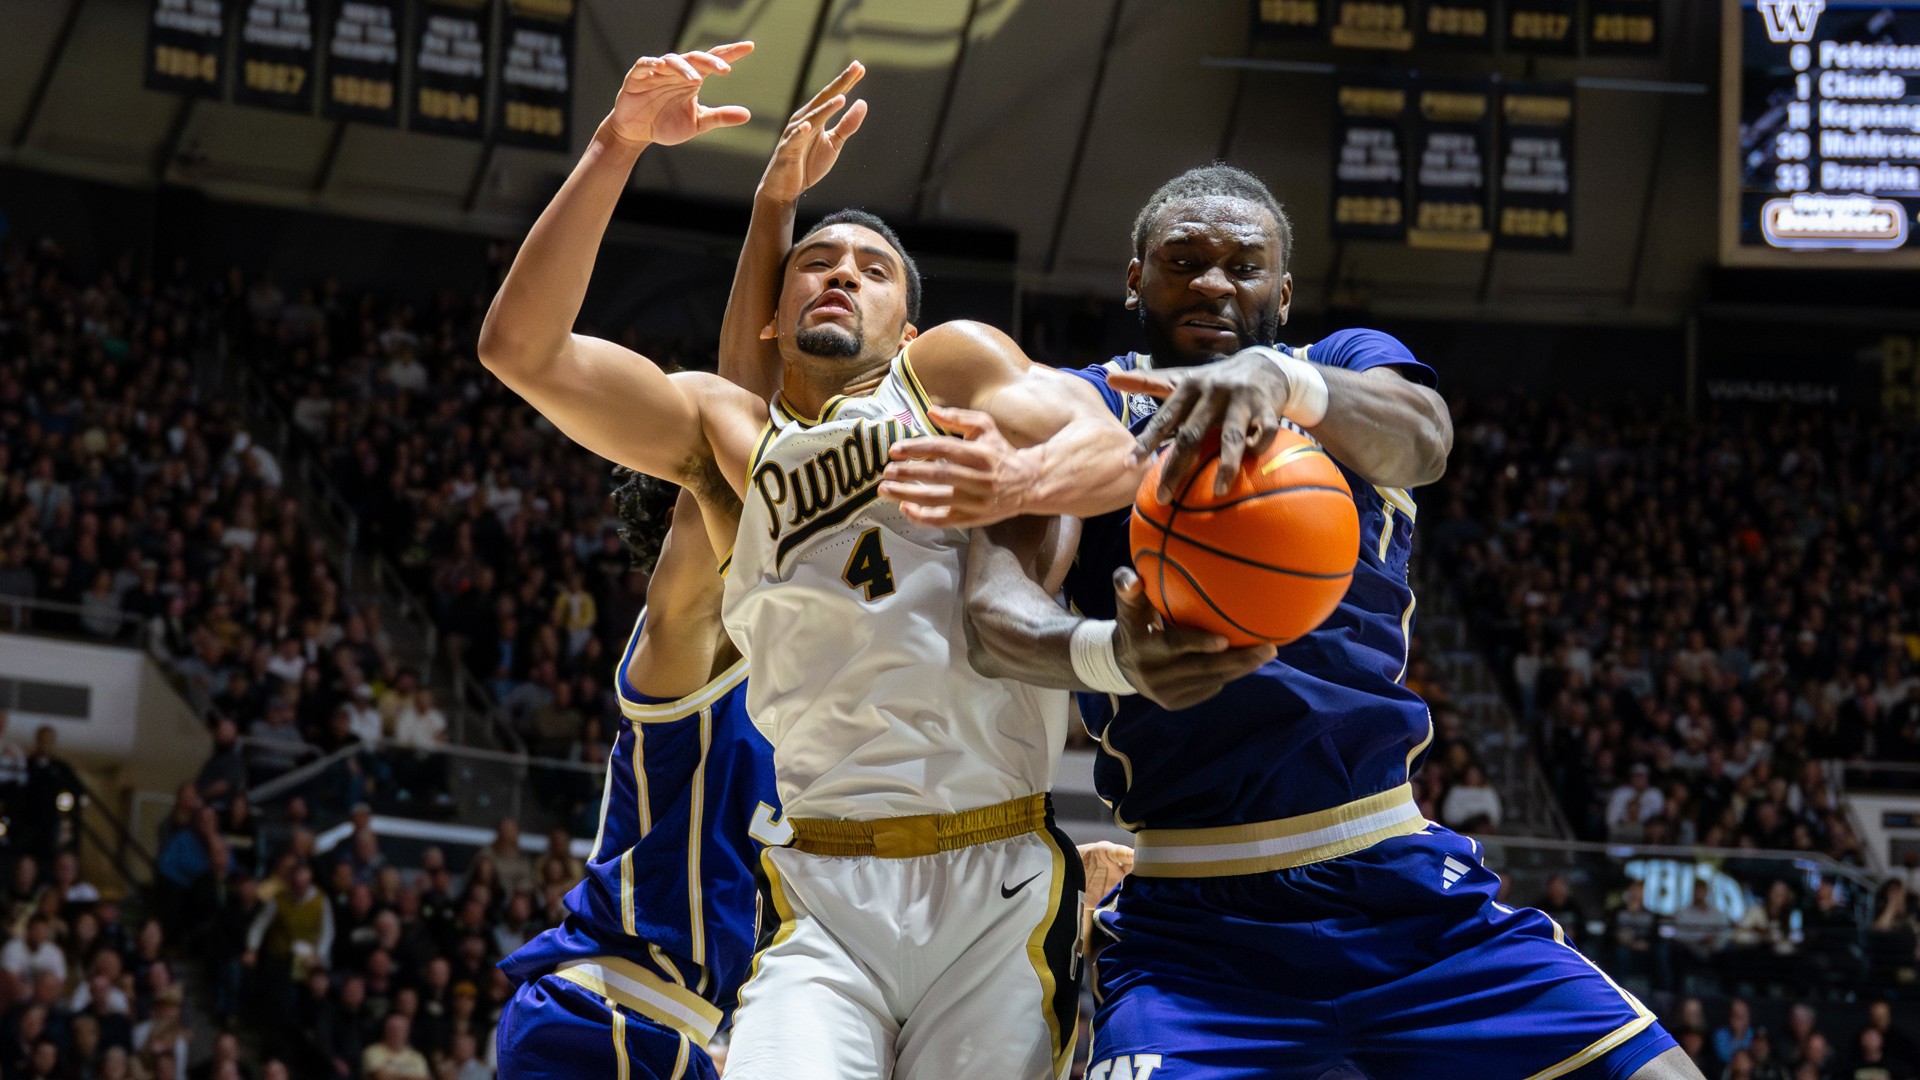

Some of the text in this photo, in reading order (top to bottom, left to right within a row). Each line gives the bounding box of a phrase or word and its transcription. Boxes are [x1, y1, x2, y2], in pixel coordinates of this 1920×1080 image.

[1795, 70, 1906, 100] 1 Claude
[1776, 163, 1810, 191] 33
[752, 417, 920, 541] Purdu
[841, 526, 896, 602] 4
